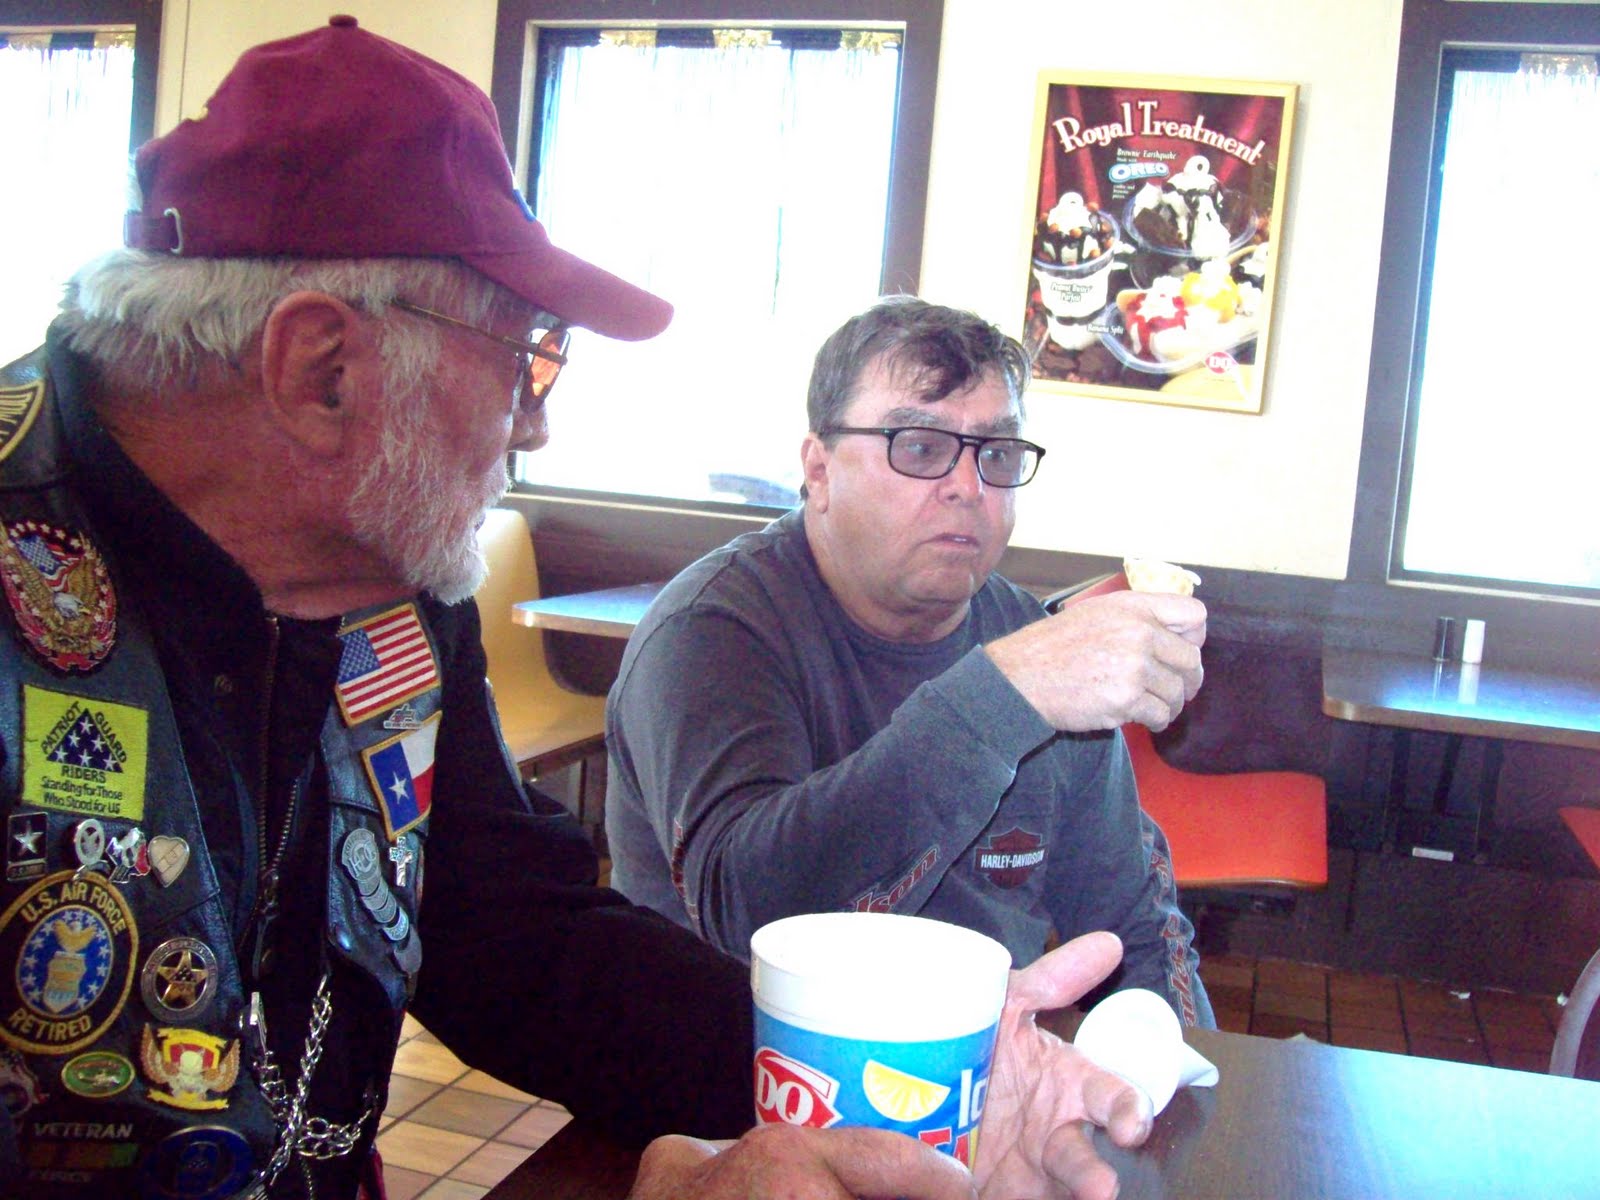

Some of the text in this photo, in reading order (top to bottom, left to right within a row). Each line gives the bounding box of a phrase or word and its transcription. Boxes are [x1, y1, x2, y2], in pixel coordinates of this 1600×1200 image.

[1052, 100, 1266, 166] Royal Treatment
[1109, 162, 1170, 182] OREO
[41, 701, 127, 763] PATRIOT GUARD
[61, 765, 106, 783] RIDERS
[42, 776, 82, 797] Standing
[97, 786, 123, 800] Those
[66, 796, 92, 810] Stood
[980, 848, 1046, 869] HARLEY-DAVIDSON
[20, 881, 126, 935] U.S. AIR FORCE
[9, 1008, 92, 1041] RETIRED
[757, 1062, 814, 1124] DQ
[34, 1122, 134, 1139] VETERAN
